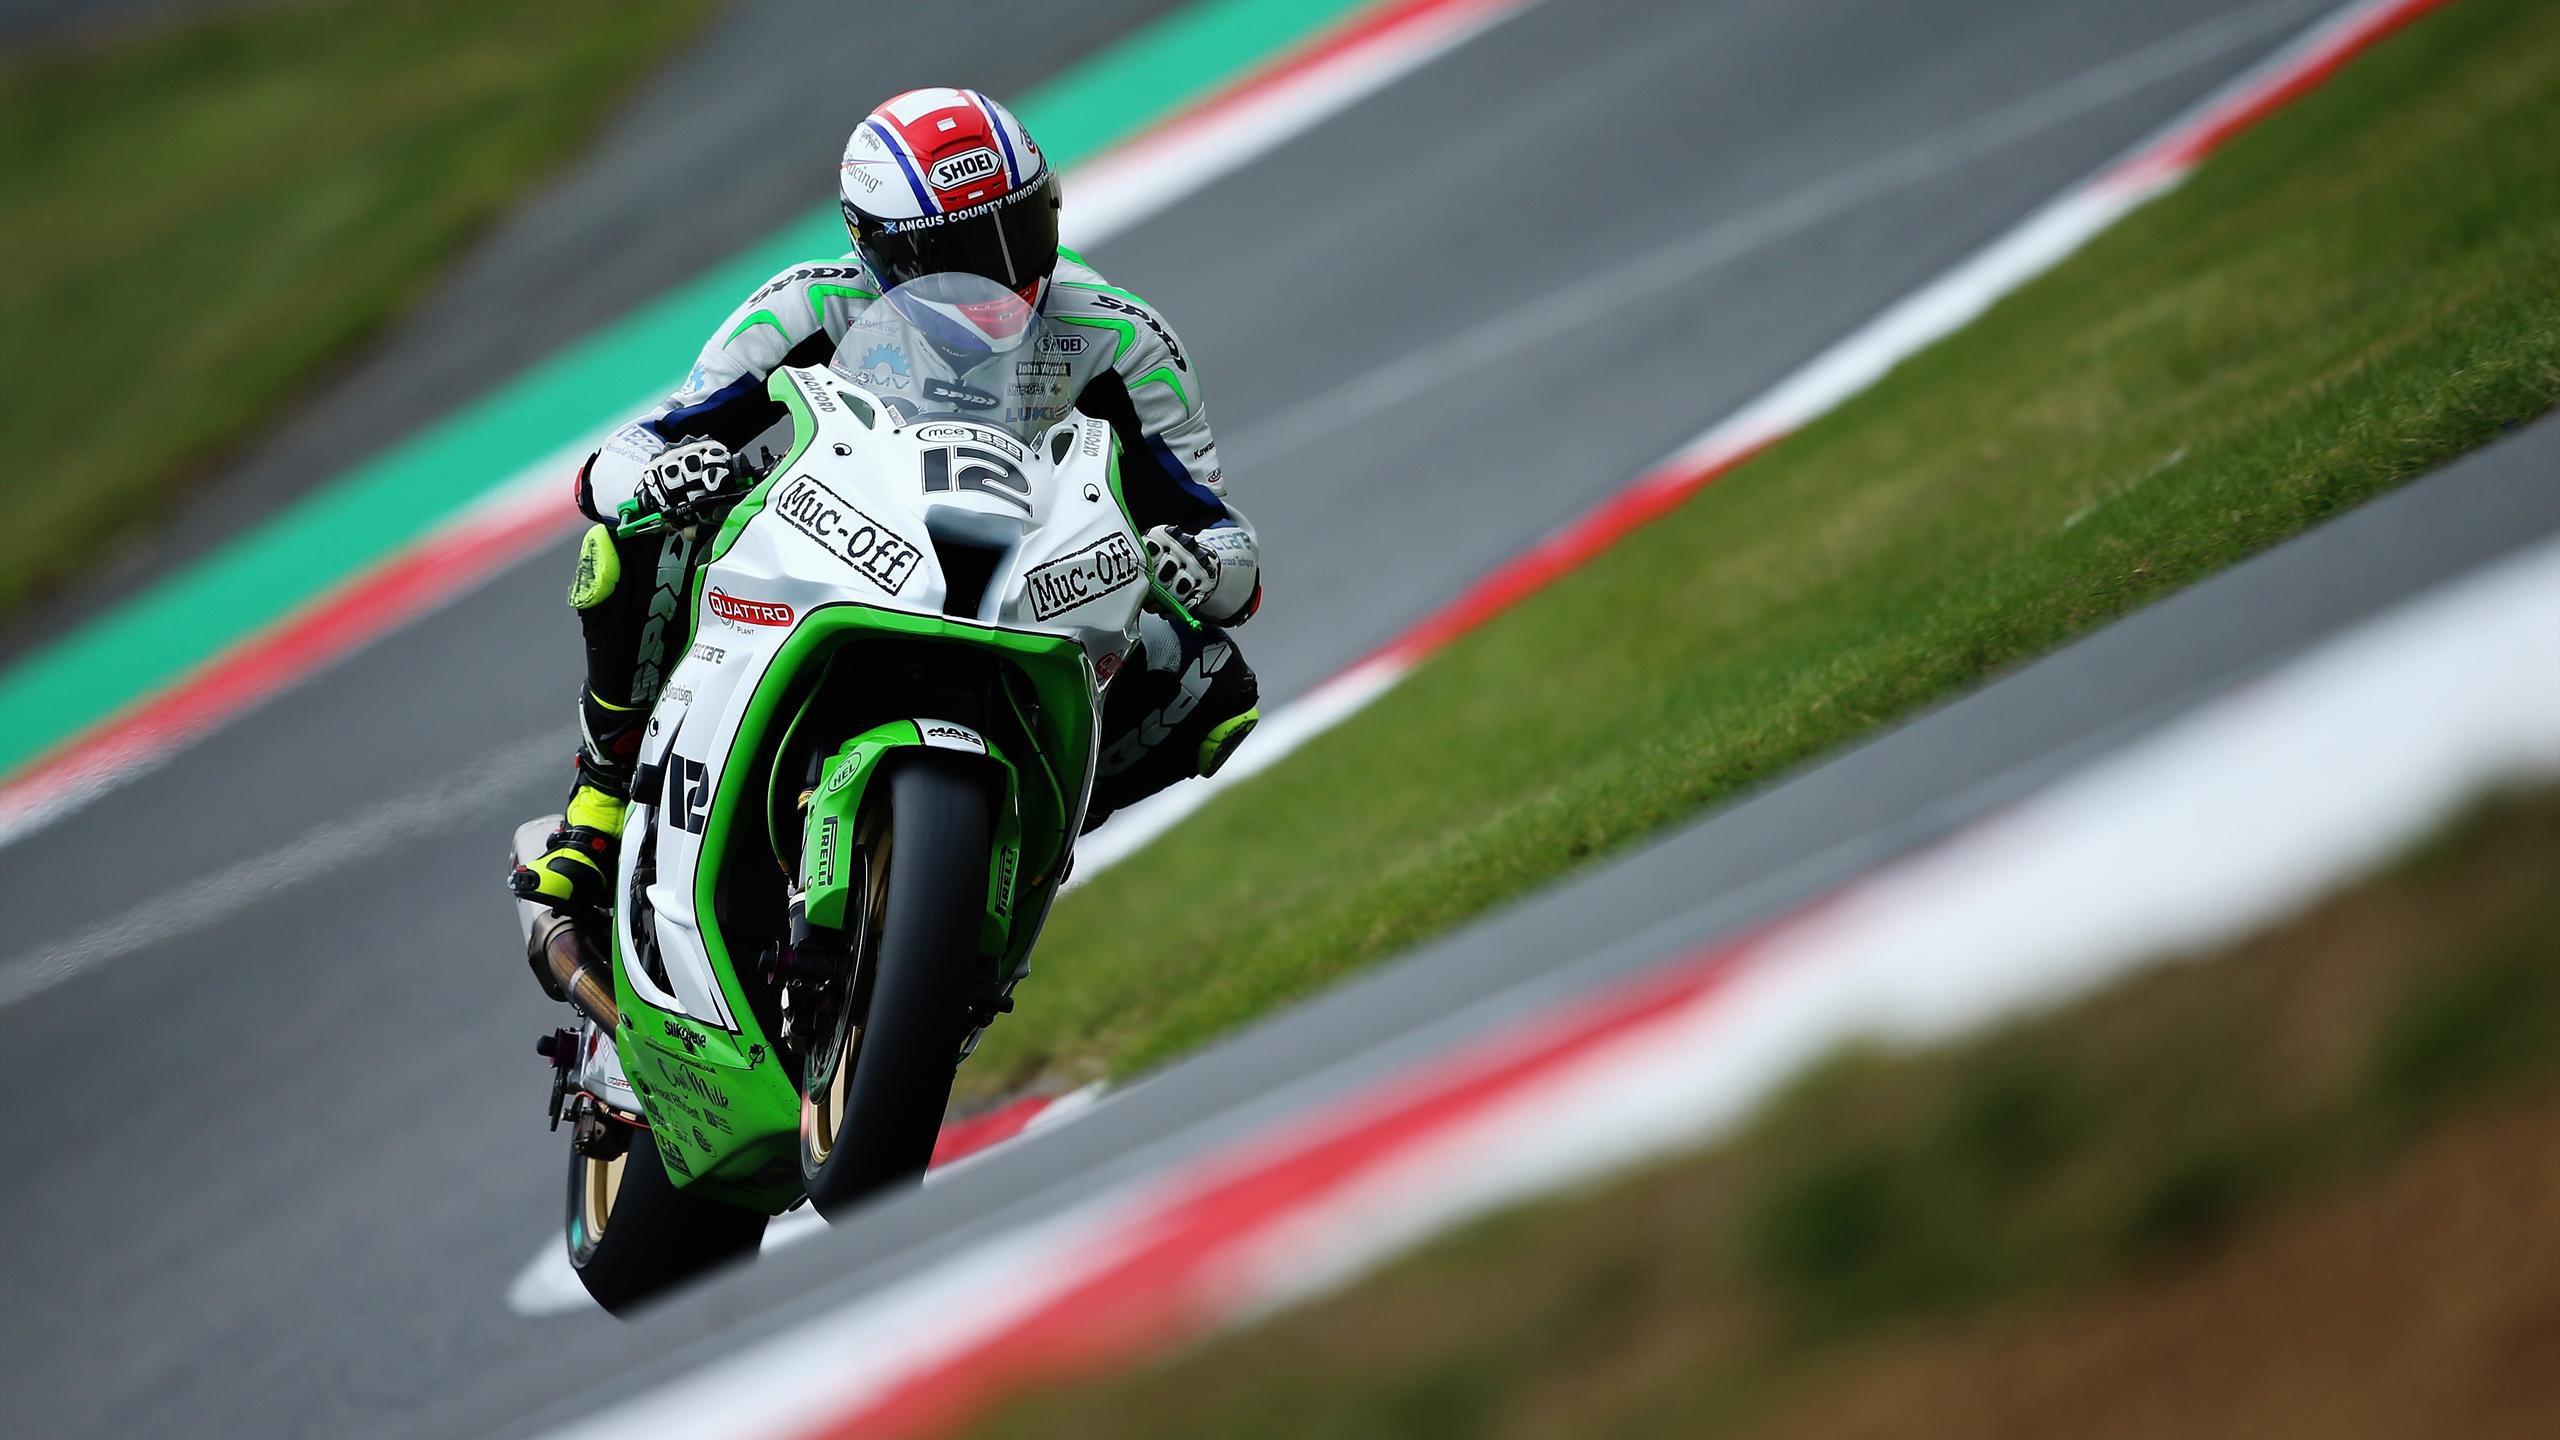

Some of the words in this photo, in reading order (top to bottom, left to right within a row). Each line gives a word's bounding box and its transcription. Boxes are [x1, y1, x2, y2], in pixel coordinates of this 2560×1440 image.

[938, 154, 994, 184] SHOEI
[898, 212, 945, 232] ANGUS
[948, 198, 1003, 222] COUNTY
[749, 267, 860, 308] SPIDI
[1041, 337, 1082, 353] SHOEI
[1089, 294, 1188, 373] SPIDI
[803, 381, 837, 413] OXFORD
[933, 386, 997, 406] SPIDI
[928, 428, 965, 438] mce
[921, 445, 1033, 518] 12
[1033, 538, 1134, 613] Muc-Off
[711, 596, 790, 622] QUATTRO
[736, 626, 755, 636] PLANT
[833, 764, 856, 787] HEL
[669, 752, 710, 836] 12
[818, 815, 839, 888] PIRELLI
[995, 845, 1015, 917] PIRELLI
